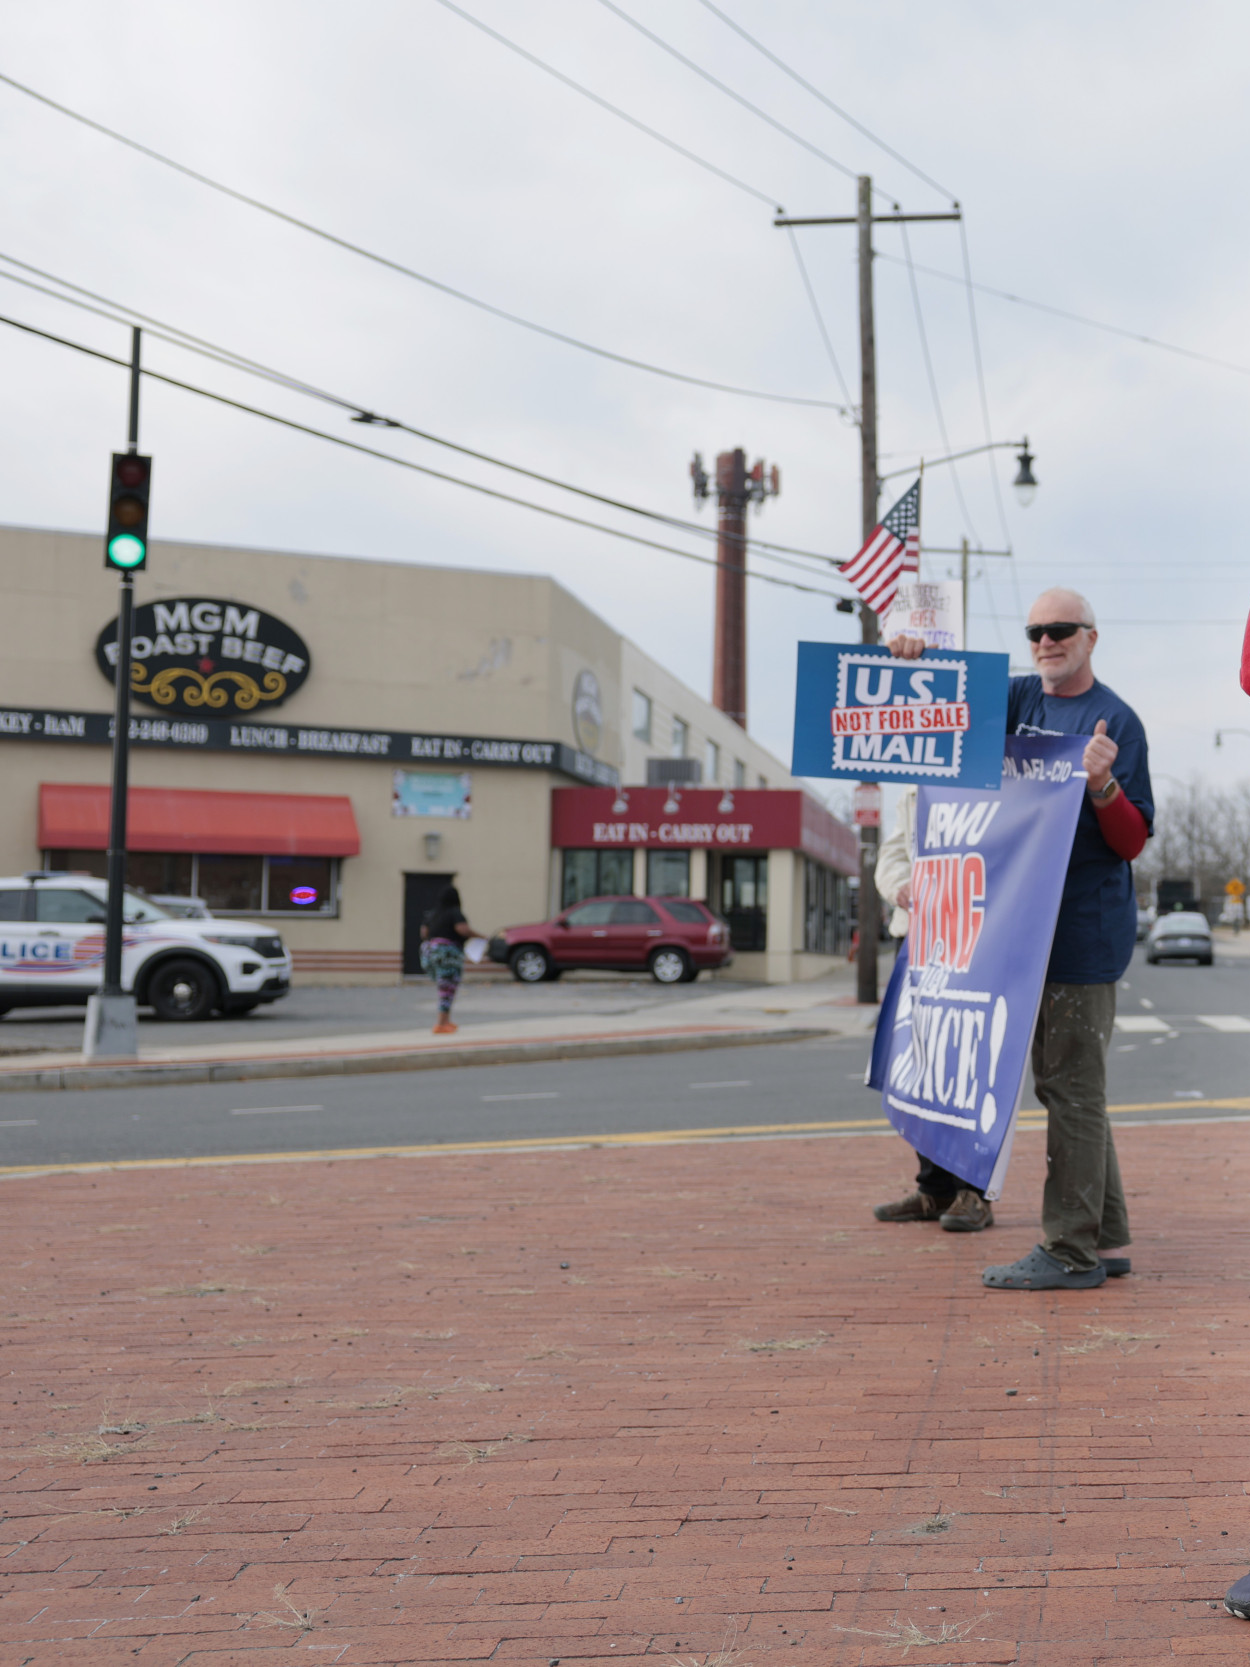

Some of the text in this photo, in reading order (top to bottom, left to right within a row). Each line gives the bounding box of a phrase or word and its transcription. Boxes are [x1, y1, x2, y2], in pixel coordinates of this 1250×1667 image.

[153, 601, 261, 640] MGM
[220, 635, 306, 674] BEEF
[855, 666, 948, 706] U.S.
[835, 706, 965, 732] NOT FOR SALE
[230, 725, 289, 749] LUNCH
[298, 729, 392, 754] BREAKFAST
[471, 740, 522, 762] CARRY
[522, 744, 554, 764] OUT
[849, 734, 945, 765] MAIL
[1022, 758, 1073, 783] AFL-CIO
[592, 822, 753, 844] EAT IN CARRY OUT
[923, 800, 1002, 850] APWU
[1, 943, 71, 960] LICE
